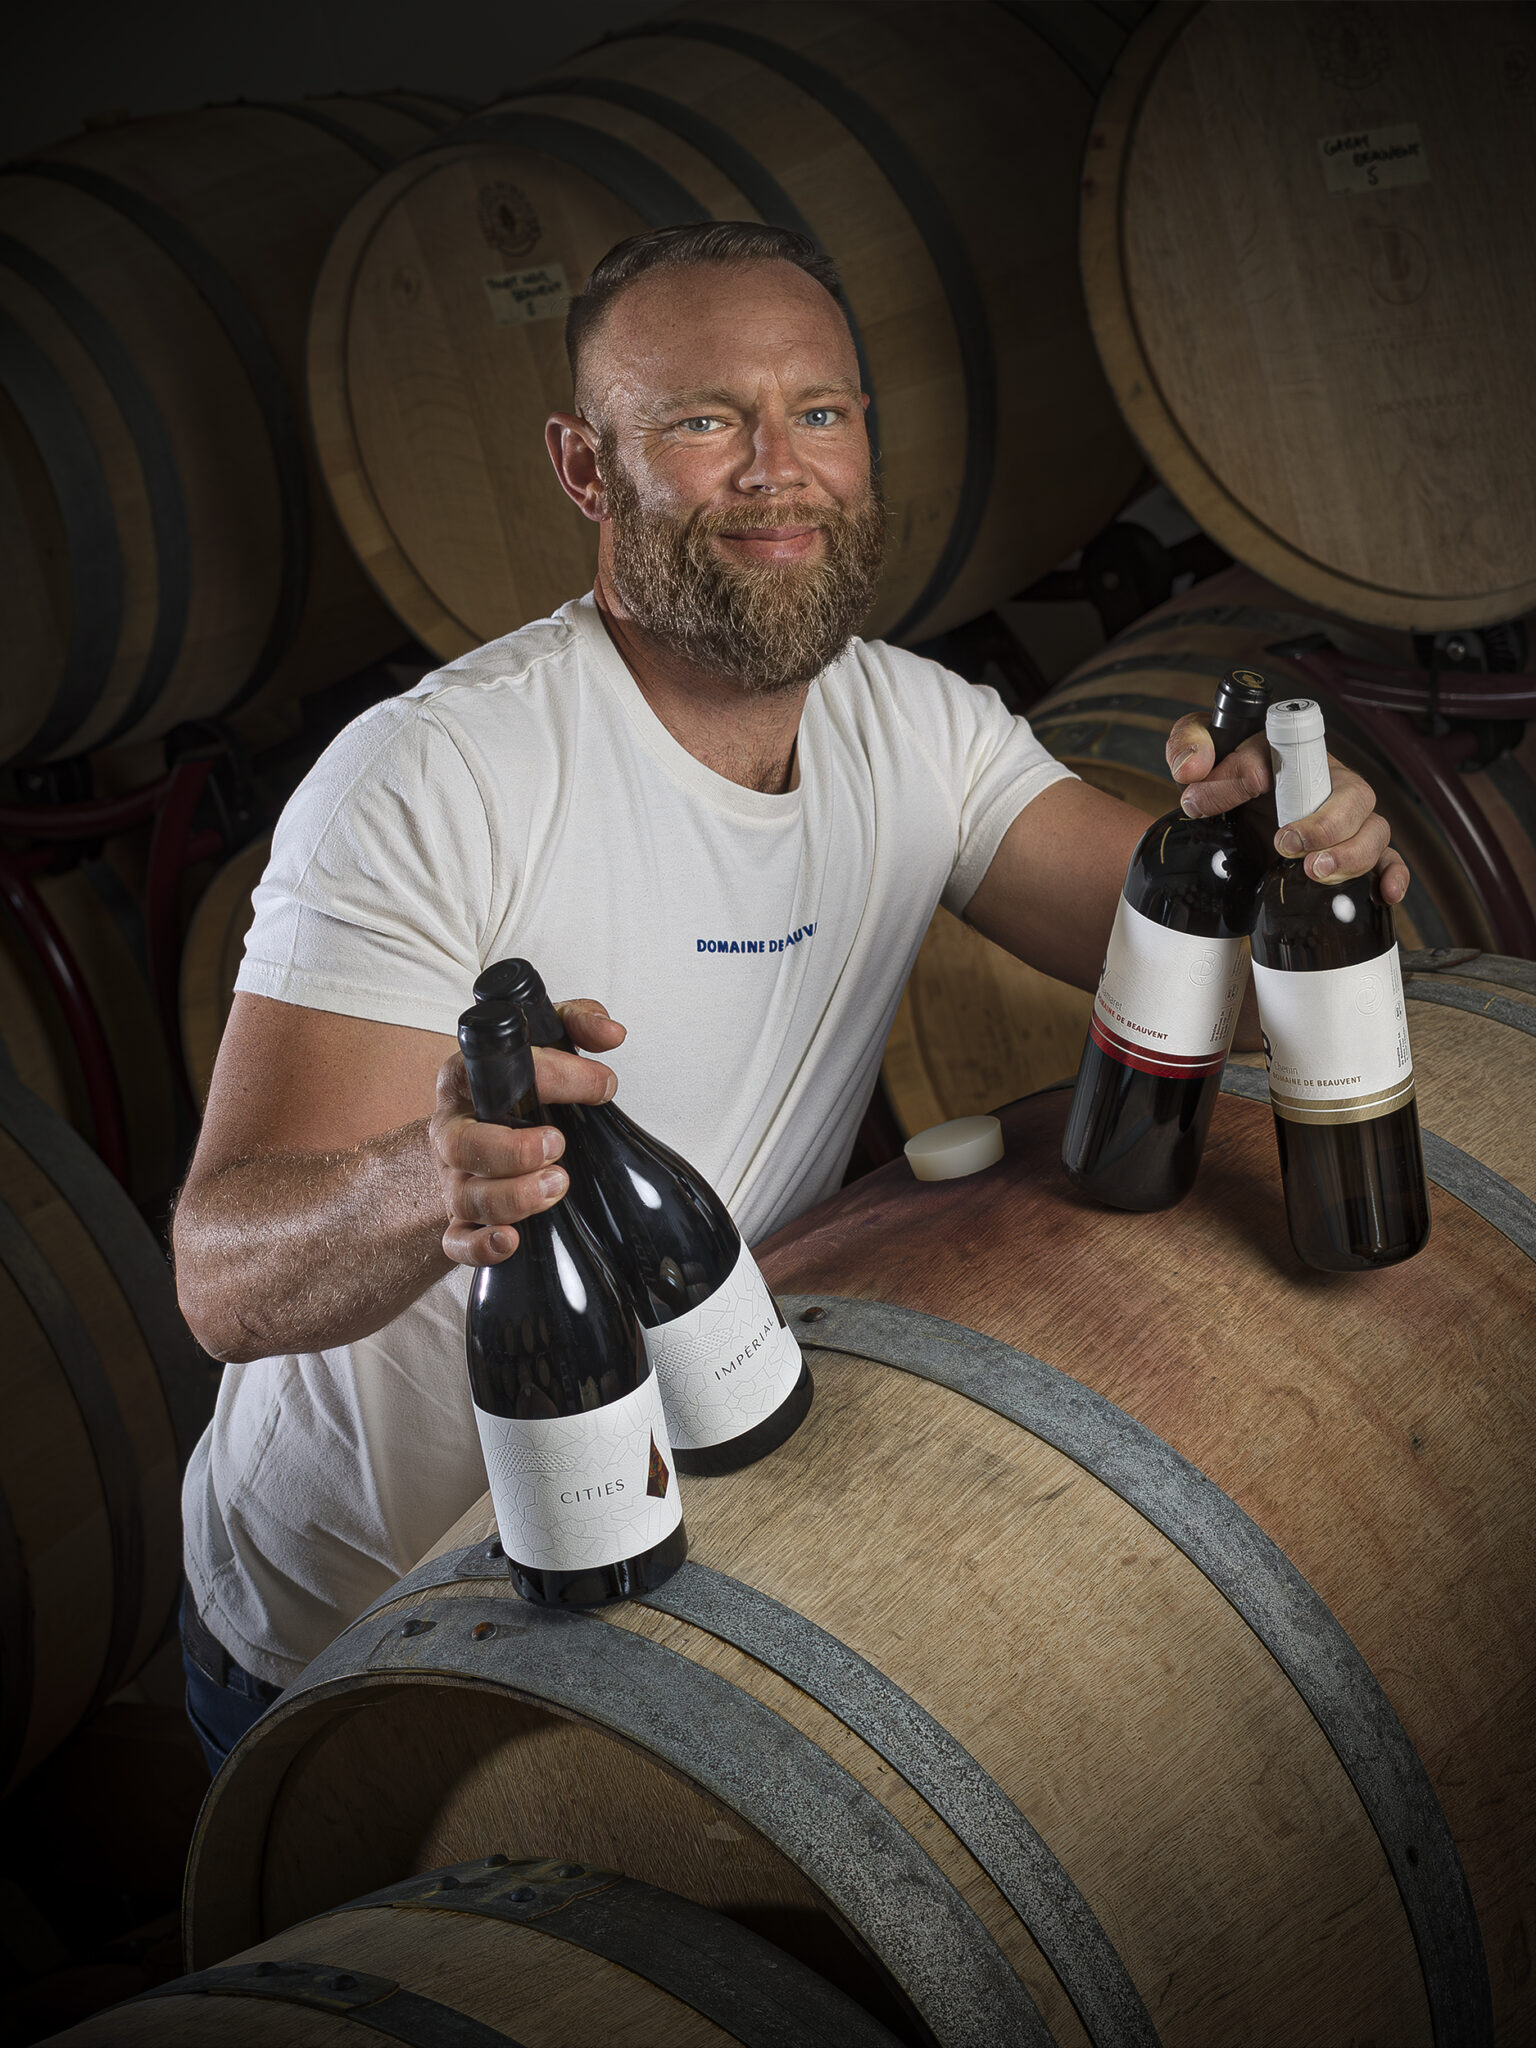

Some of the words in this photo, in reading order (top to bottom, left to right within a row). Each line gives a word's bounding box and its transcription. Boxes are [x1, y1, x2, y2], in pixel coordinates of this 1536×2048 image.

[696, 939, 765, 953] DOMAINE
[768, 939, 785, 953] DE
[1116, 1014, 1126, 1025] DE
[1126, 1019, 1169, 1041] BEAUVENT
[1272, 1072, 1302, 1086] DOMAINE
[1303, 1078, 1315, 1087] DE
[1317, 1075, 1362, 1087] BEAUVENT
[714, 1317, 774, 1381] IMPÉRIAL
[560, 1478, 625, 1505] CITIES
